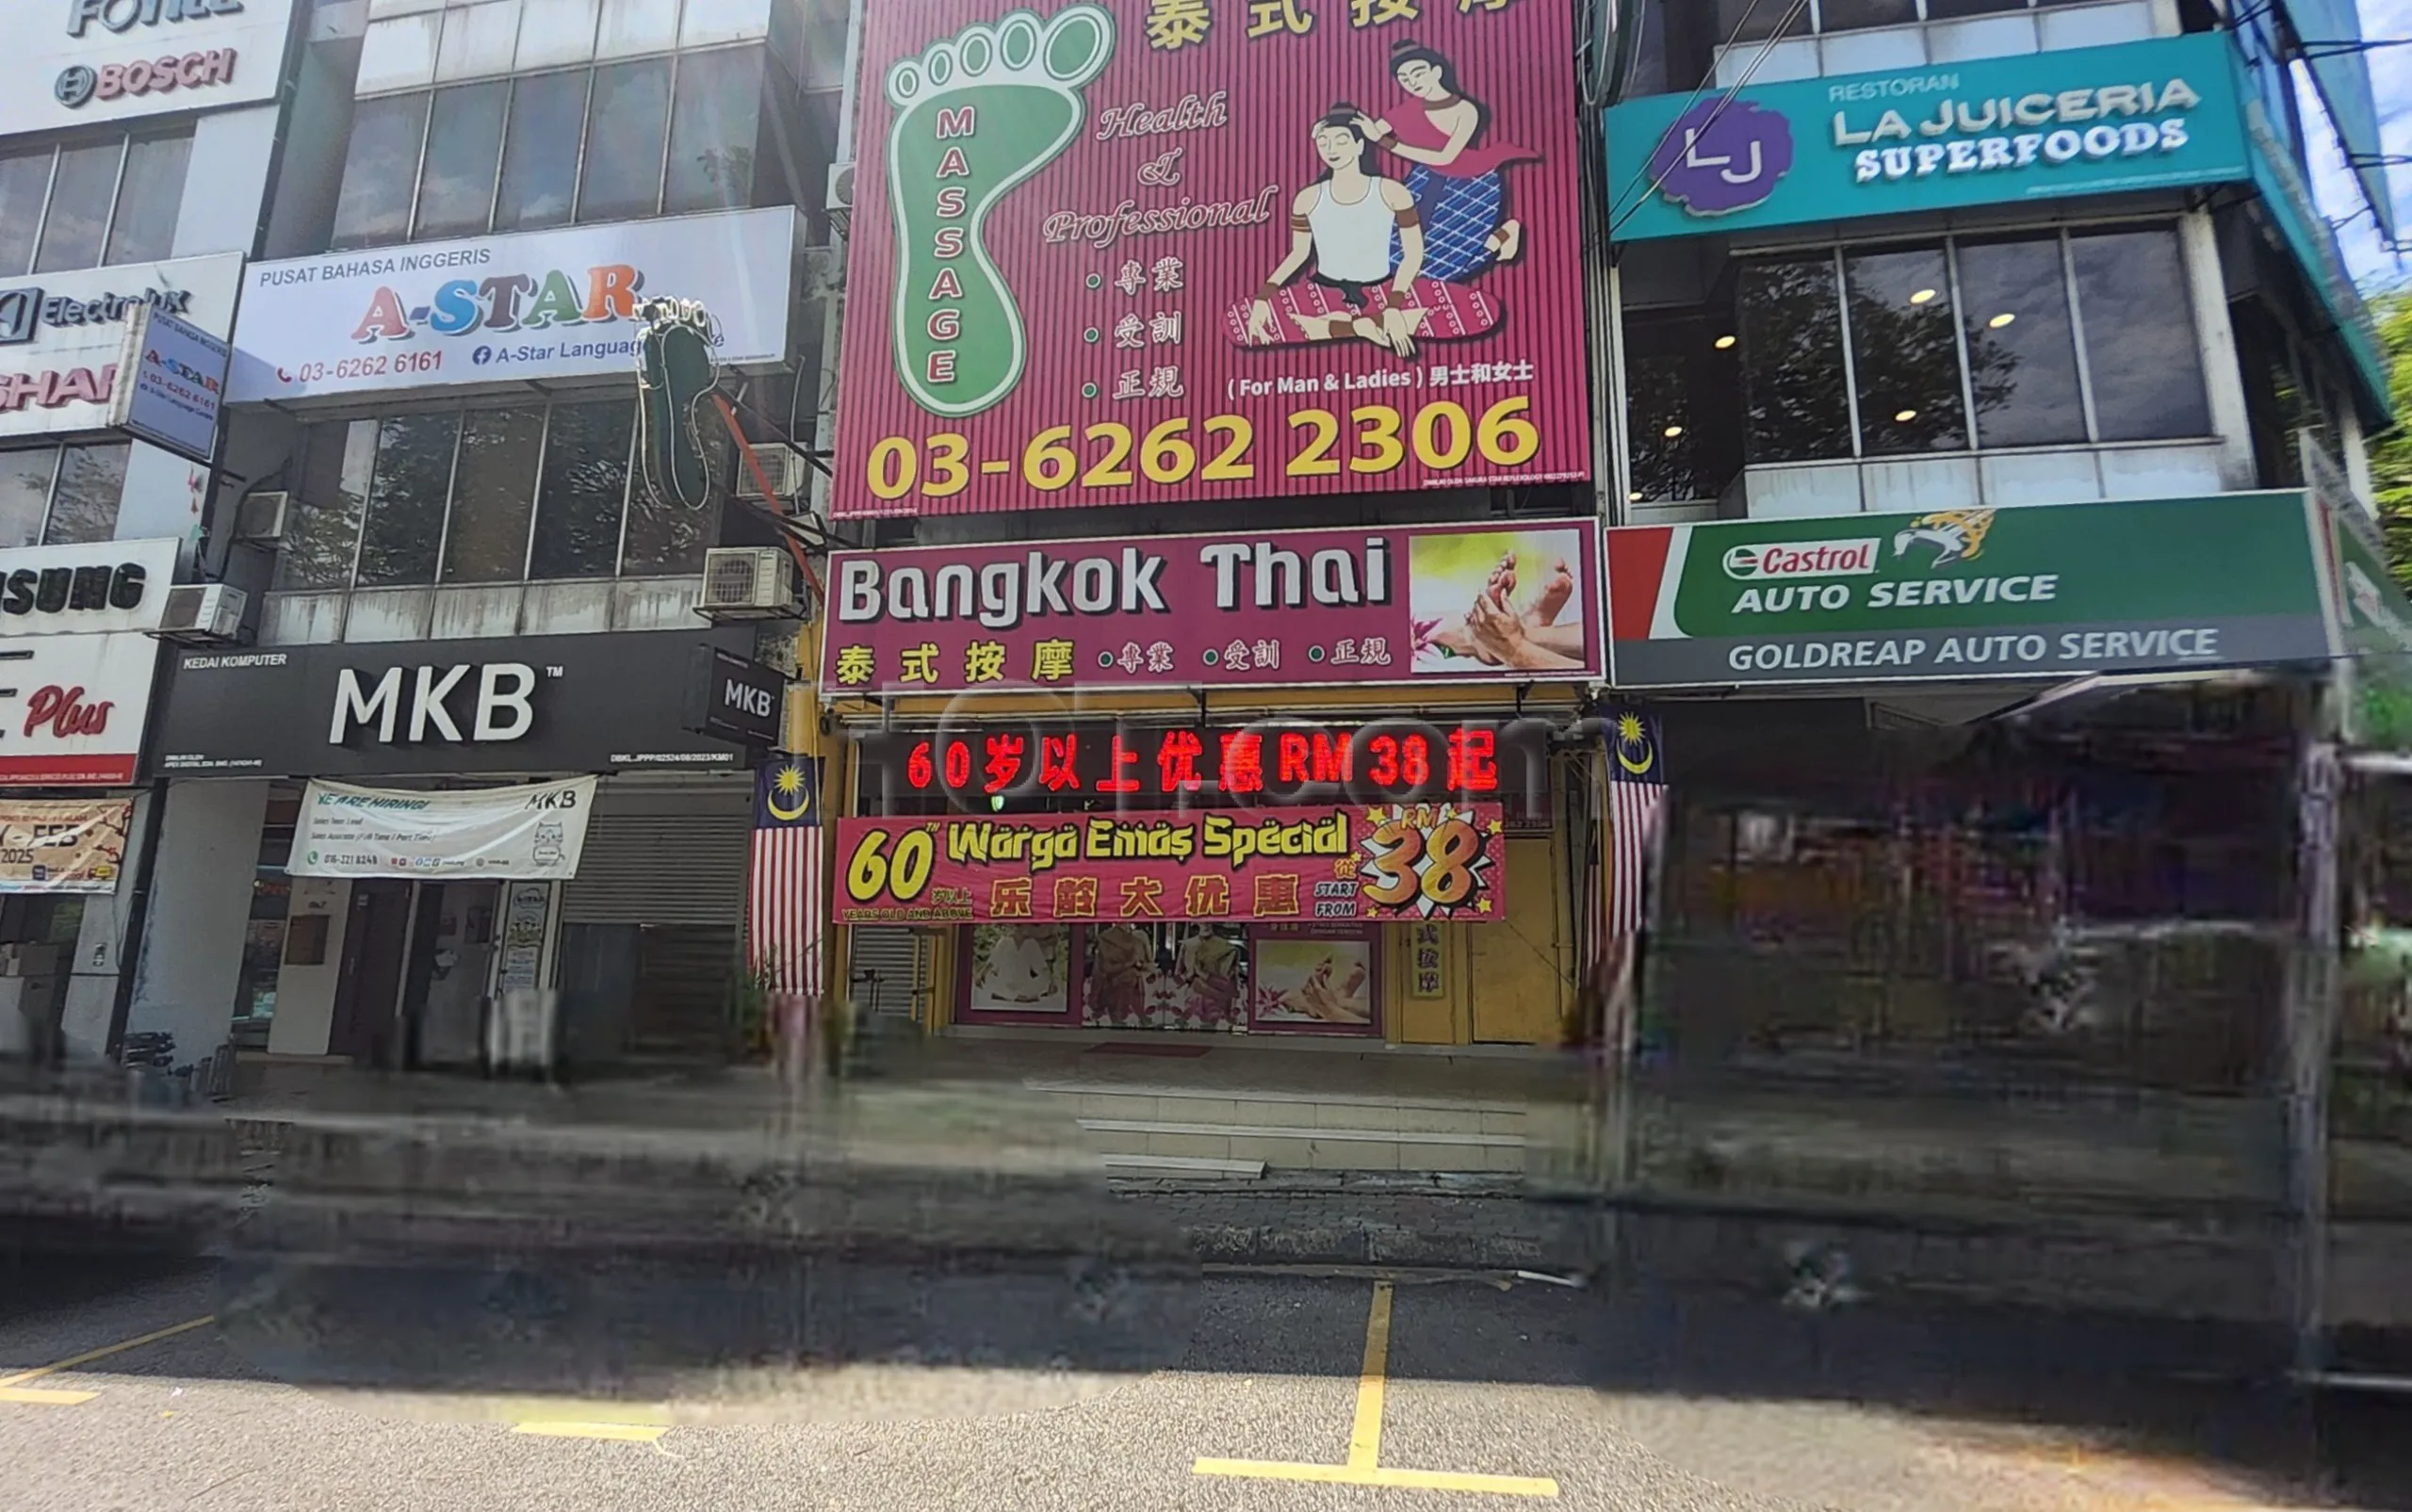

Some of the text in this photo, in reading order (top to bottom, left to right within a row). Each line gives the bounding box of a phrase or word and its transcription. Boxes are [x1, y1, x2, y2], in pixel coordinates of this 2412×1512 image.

[97, 48, 236, 99] BOSCH
[1830, 73, 1958, 103] RESTORAN
[1097, 91, 1229, 139] Health
[1833, 78, 2201, 146] LA JUICERIA
[1137, 148, 1183, 187] &
[1685, 128, 1761, 184] LJ
[1855, 118, 2189, 182] SUPERFOODS
[1043, 186, 1279, 250] Professional
[927, 106, 975, 382] MASSAGE
[260, 249, 491, 287] PUSAT BAHASA INGGERIS
[350, 265, 644, 343] A-STAR
[145, 349, 220, 395] A-STAR
[299, 350, 443, 383] 03-6262 6161
[496, 340, 647, 364] A-Star Languag
[1112, 365, 1185, 400] 正規
[1277, 373, 1319, 395] Man
[1323, 373, 1341, 392] &
[1429, 359, 1535, 387] 男士和女士
[867, 396, 1540, 500] 03-6262 2306
[1761, 543, 1869, 574] Castrol
[839, 537, 1388, 628] Bangkok Thai
[1731, 574, 2060, 614] AUTO SERVICE
[184, 654, 286, 670] KEDAI KOMPUTER
[836, 638, 1075, 685] 泰式按摩
[1330, 637, 1393, 665] 正規
[1729, 627, 2219, 672] GOLDREAP AUTO SERVICE
[24, 685, 115, 738] Plus
[330, 663, 535, 743] MKB
[725, 678, 772, 717] MKB
[334, 795, 368, 807] ARE
[525, 790, 577, 810] MKB
[1, 849, 34, 864] 2025
[947, 818, 1078, 871] Warga
[1085, 817, 1194, 864] Emas
[1203, 809, 1350, 870] Special
[1362, 806, 1479, 904] RM 38
[1313, 882, 1357, 899] START
[1315, 902, 1357, 918] FROM
[842, 906, 973, 920] YEARS OLD AND ABOVE
